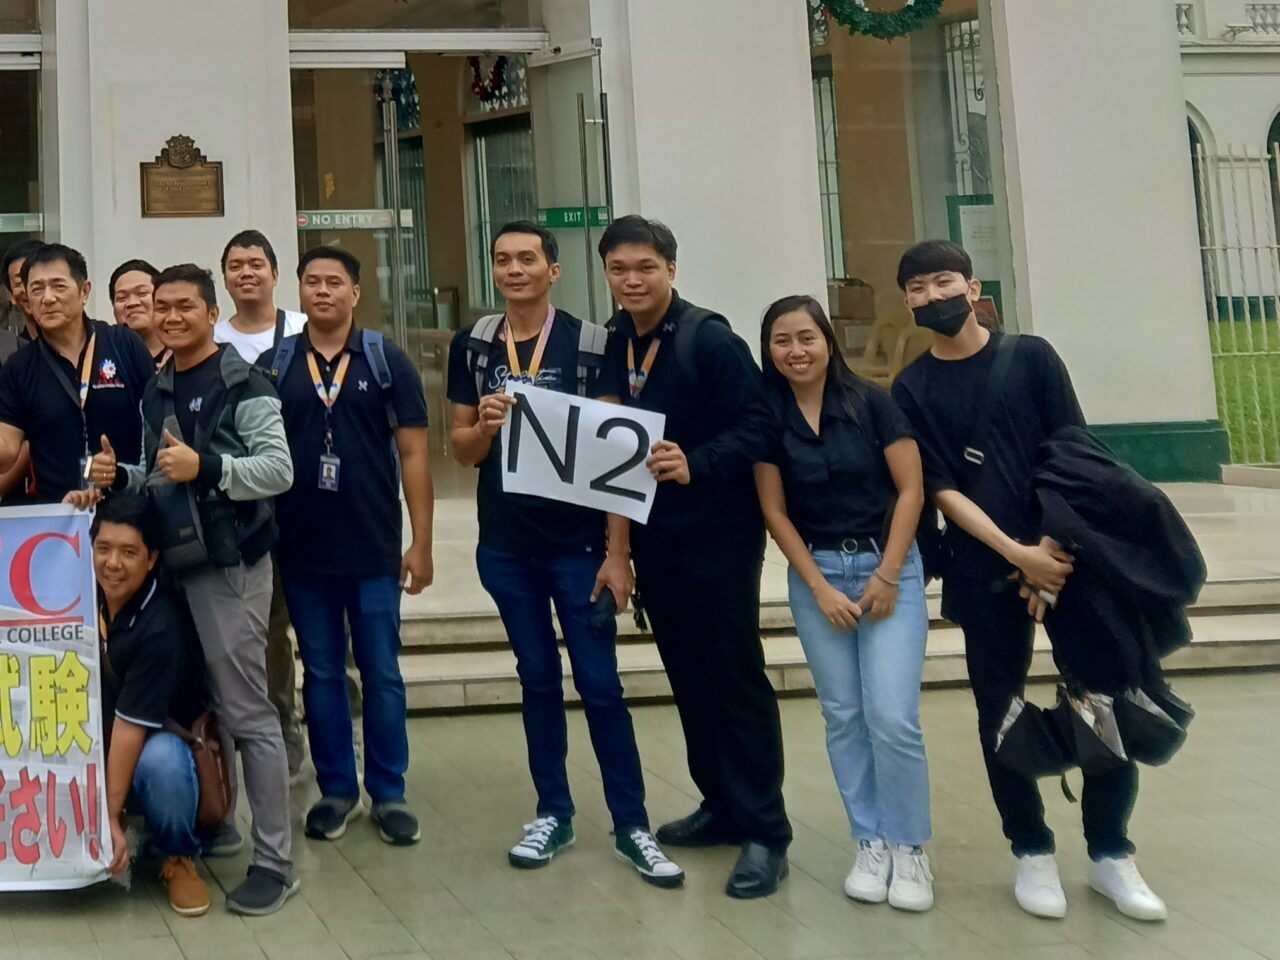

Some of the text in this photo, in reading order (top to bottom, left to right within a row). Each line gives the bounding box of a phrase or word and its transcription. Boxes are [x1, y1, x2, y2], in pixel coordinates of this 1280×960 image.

[312, 213, 375, 225] NO ENTRY
[563, 211, 582, 223] EXIT
[506, 391, 651, 503] N2
[6, 624, 85, 644] COLLEGE
